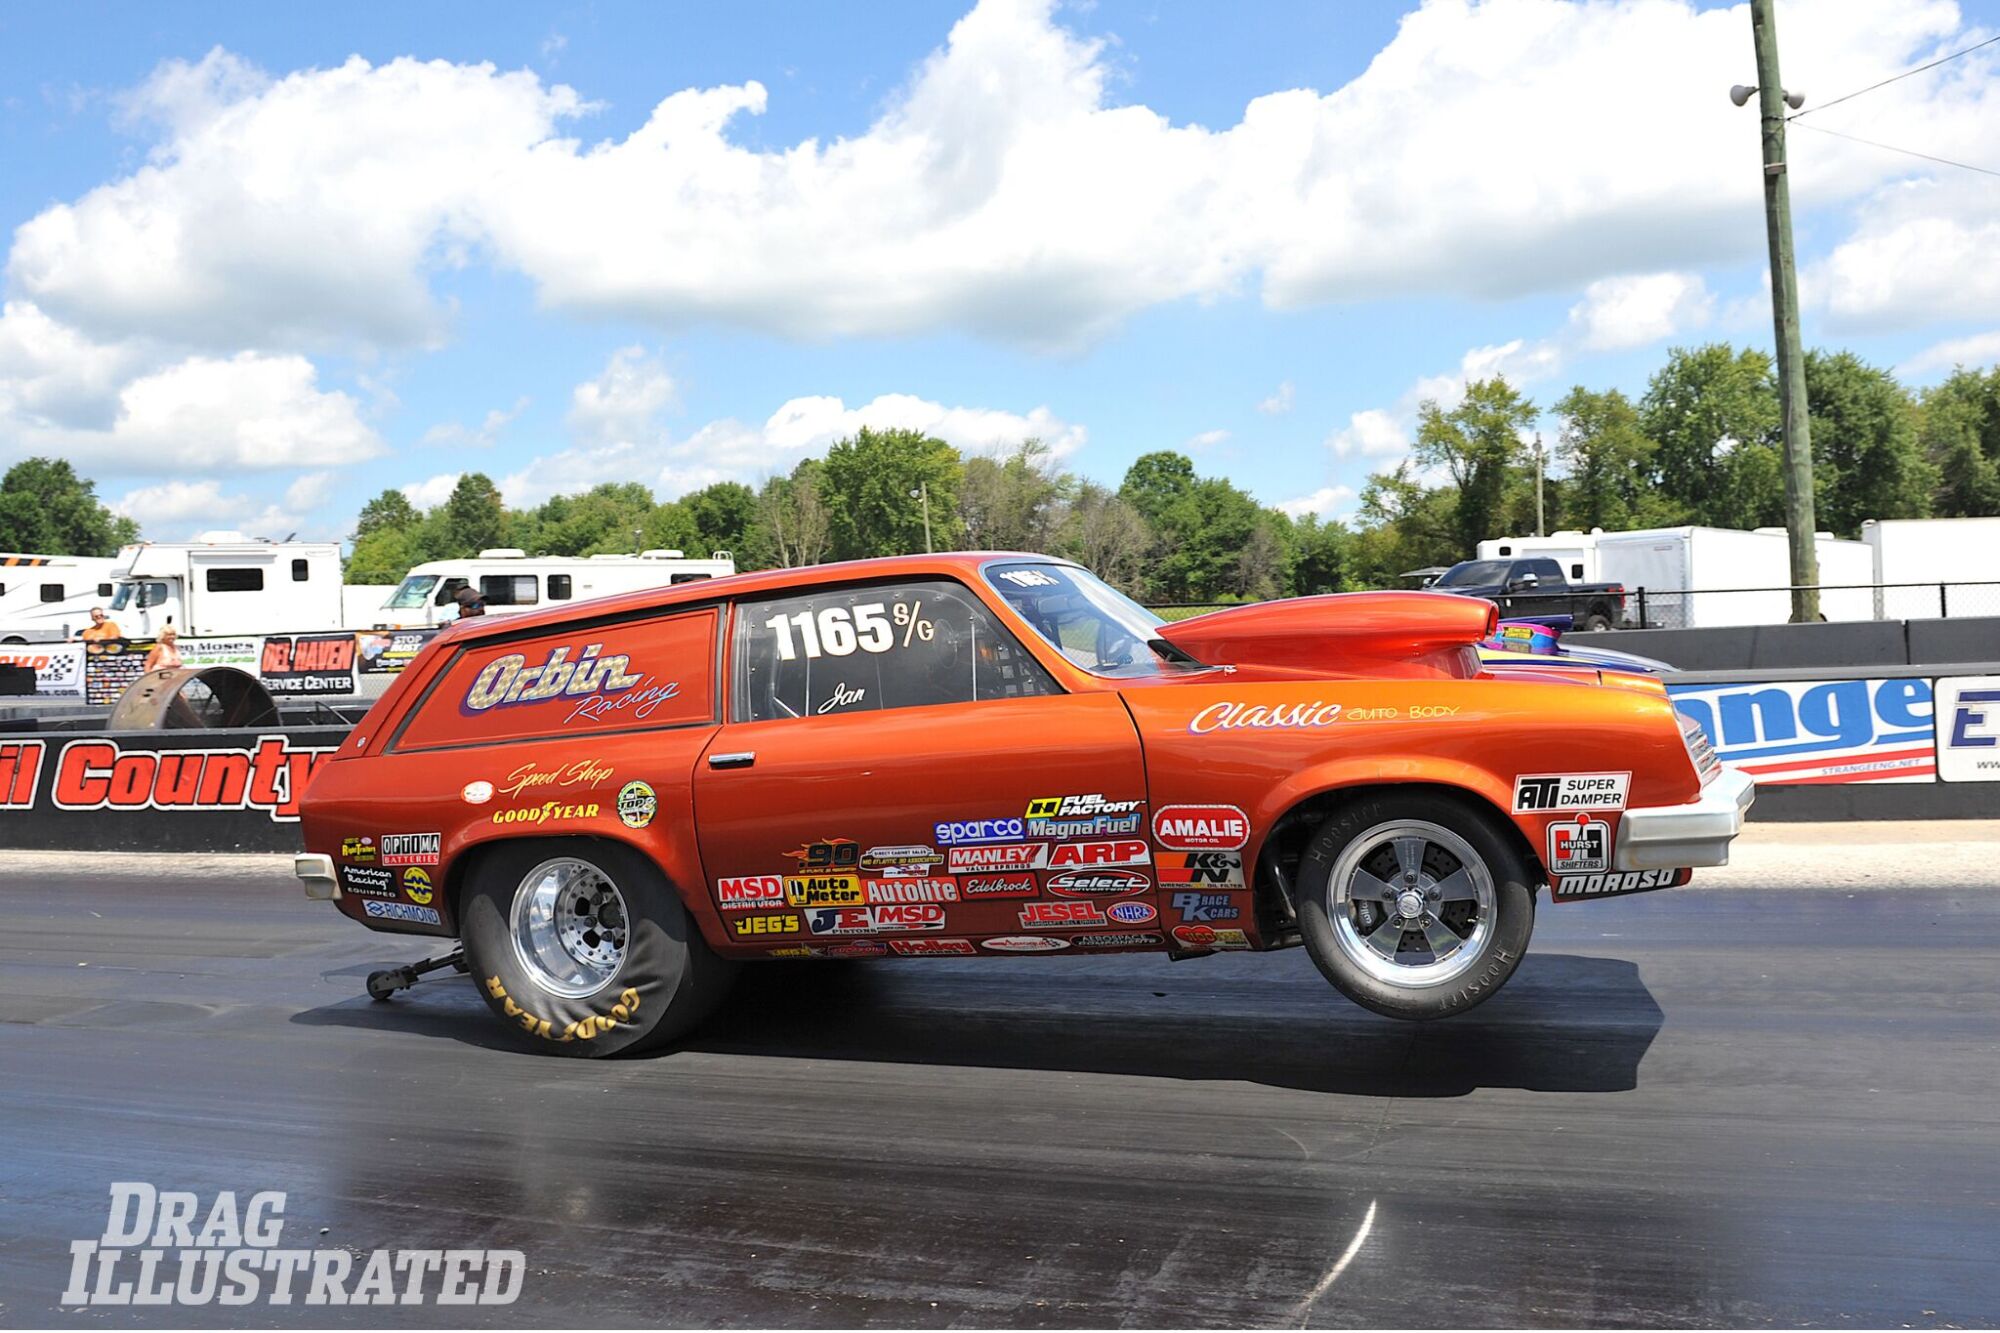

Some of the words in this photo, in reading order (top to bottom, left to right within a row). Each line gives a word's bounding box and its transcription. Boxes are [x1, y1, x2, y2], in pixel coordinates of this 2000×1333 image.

[765, 602, 895, 661] 1165
[262, 643, 291, 672] DEL
[293, 640, 355, 672] HAVEN
[35, 673, 64, 682] MS
[303, 675, 352, 690] CENTER
[462, 643, 645, 714] Orbin
[564, 676, 681, 724] Racing
[817, 682, 866, 715] Jan
[1188, 701, 1342, 735] Classic
[1822, 758, 1921, 776] STRANGEENG.NET
[54, 736, 338, 822] County
[497, 762, 570, 800] Speed
[558, 758, 614, 791] Shop
[1567, 778, 1616, 791] SUPER
[1062, 793, 1107, 806] FUEL
[1517, 778, 1561, 809] ATI
[1560, 793, 1623, 805] DAMPER
[492, 801, 600, 825] GOODYEAR
[1058, 801, 1141, 817] FACTORY
[936, 818, 1023, 845] sparco
[1028, 815, 1138, 839] MagnaFuel
[1159, 819, 1244, 837] AMALIE
[382, 834, 440, 855] OPTIMA
[1050, 841, 1147, 865] ARP
[1560, 840, 1600, 850] HURST
[384, 855, 439, 865] BATTERIES
[951, 847, 1031, 865] MANLEY
[1559, 860, 1600, 870] SHIFTERS
[343, 865, 392, 878] American
[347, 874, 388, 890] Racing
[720, 877, 781, 900] MSD
[808, 877, 849, 890] Auto
[966, 878, 1033, 895] Edelbrock
[1058, 876, 1143, 888] Select
[1558, 868, 1675, 895] MOROSO
[347, 886, 397, 898] EQUIPPED
[806, 889, 860, 902] Meter
[867, 879, 958, 903] Autolite
[1200, 895, 1230, 906] RACE
[384, 903, 439, 923] RICHMOND
[811, 907, 869, 933] JE
[878, 905, 944, 923] MSD
[1023, 902, 1103, 922] JESEL
[1114, 905, 1150, 920] NHRA
[1210, 907, 1239, 919] CARS
[736, 915, 800, 935] JEG'S
[892, 940, 971, 954] Holley
[486, 975, 641, 1042] GOODYEAR
